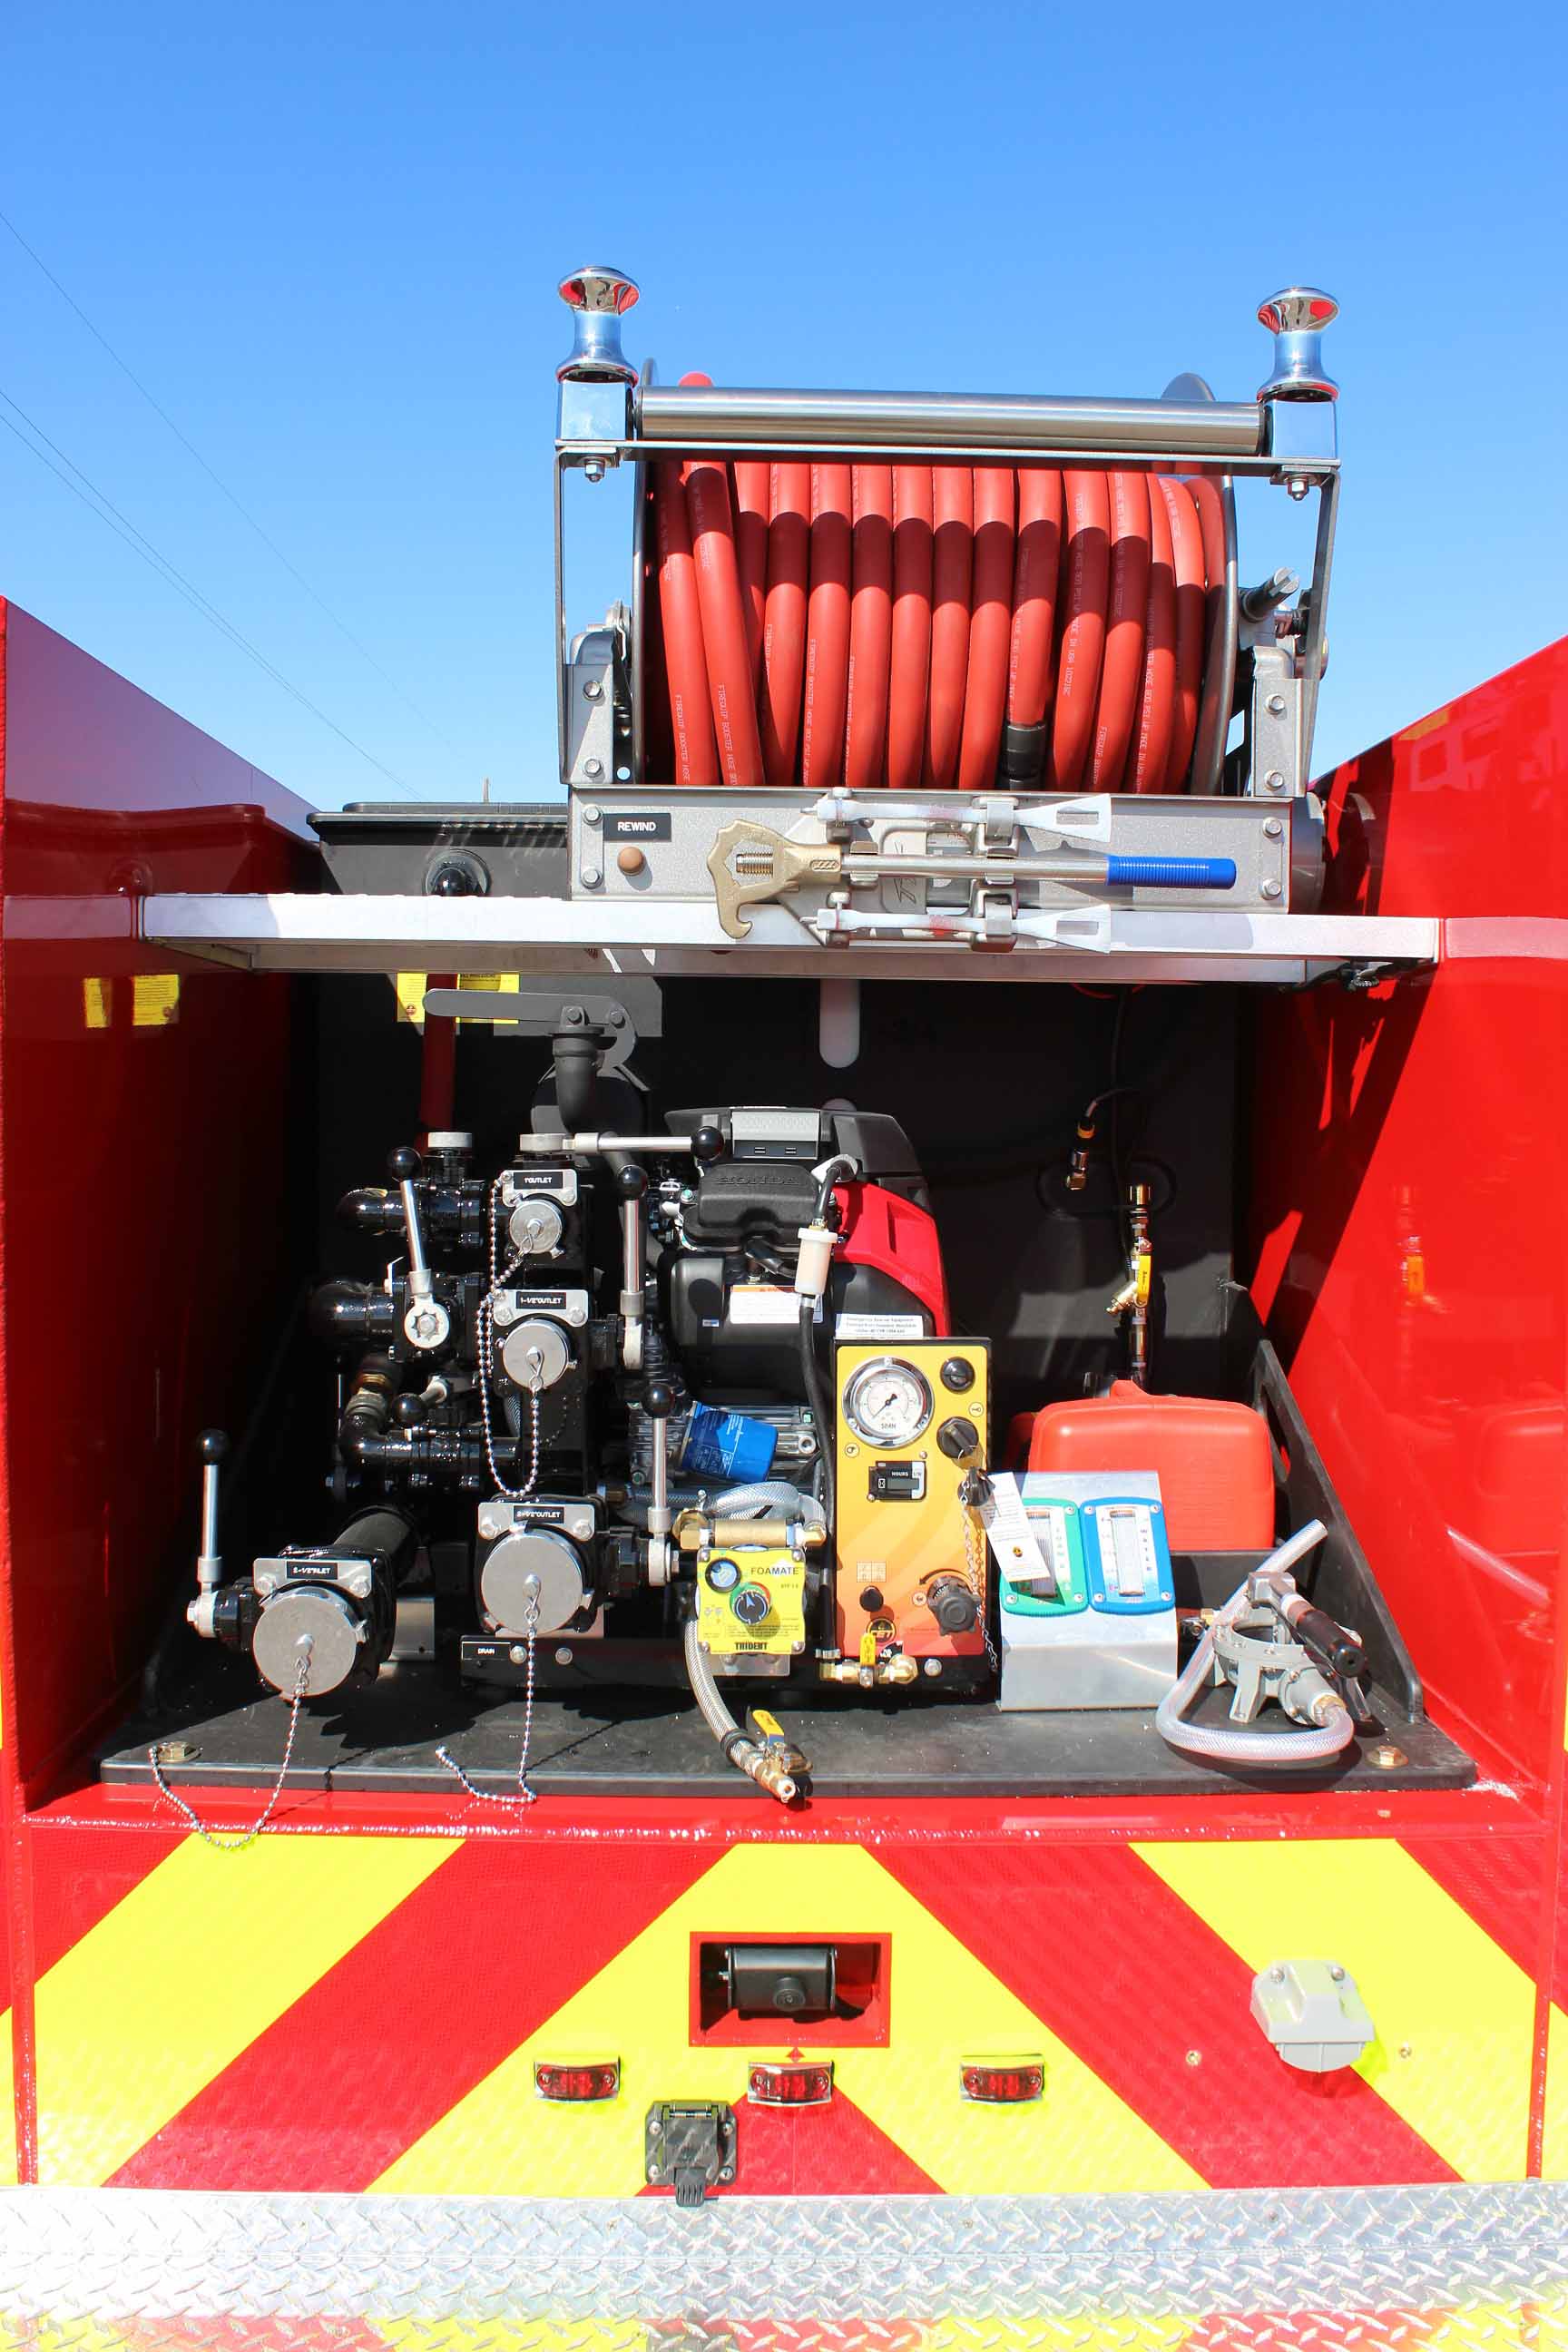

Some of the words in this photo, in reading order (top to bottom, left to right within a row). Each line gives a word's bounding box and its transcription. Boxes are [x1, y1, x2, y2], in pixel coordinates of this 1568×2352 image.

[617, 821, 657, 832] REWIND
[750, 1566, 799, 1575] FOAMATE
[734, 1642, 769, 1651] TRIDENT
